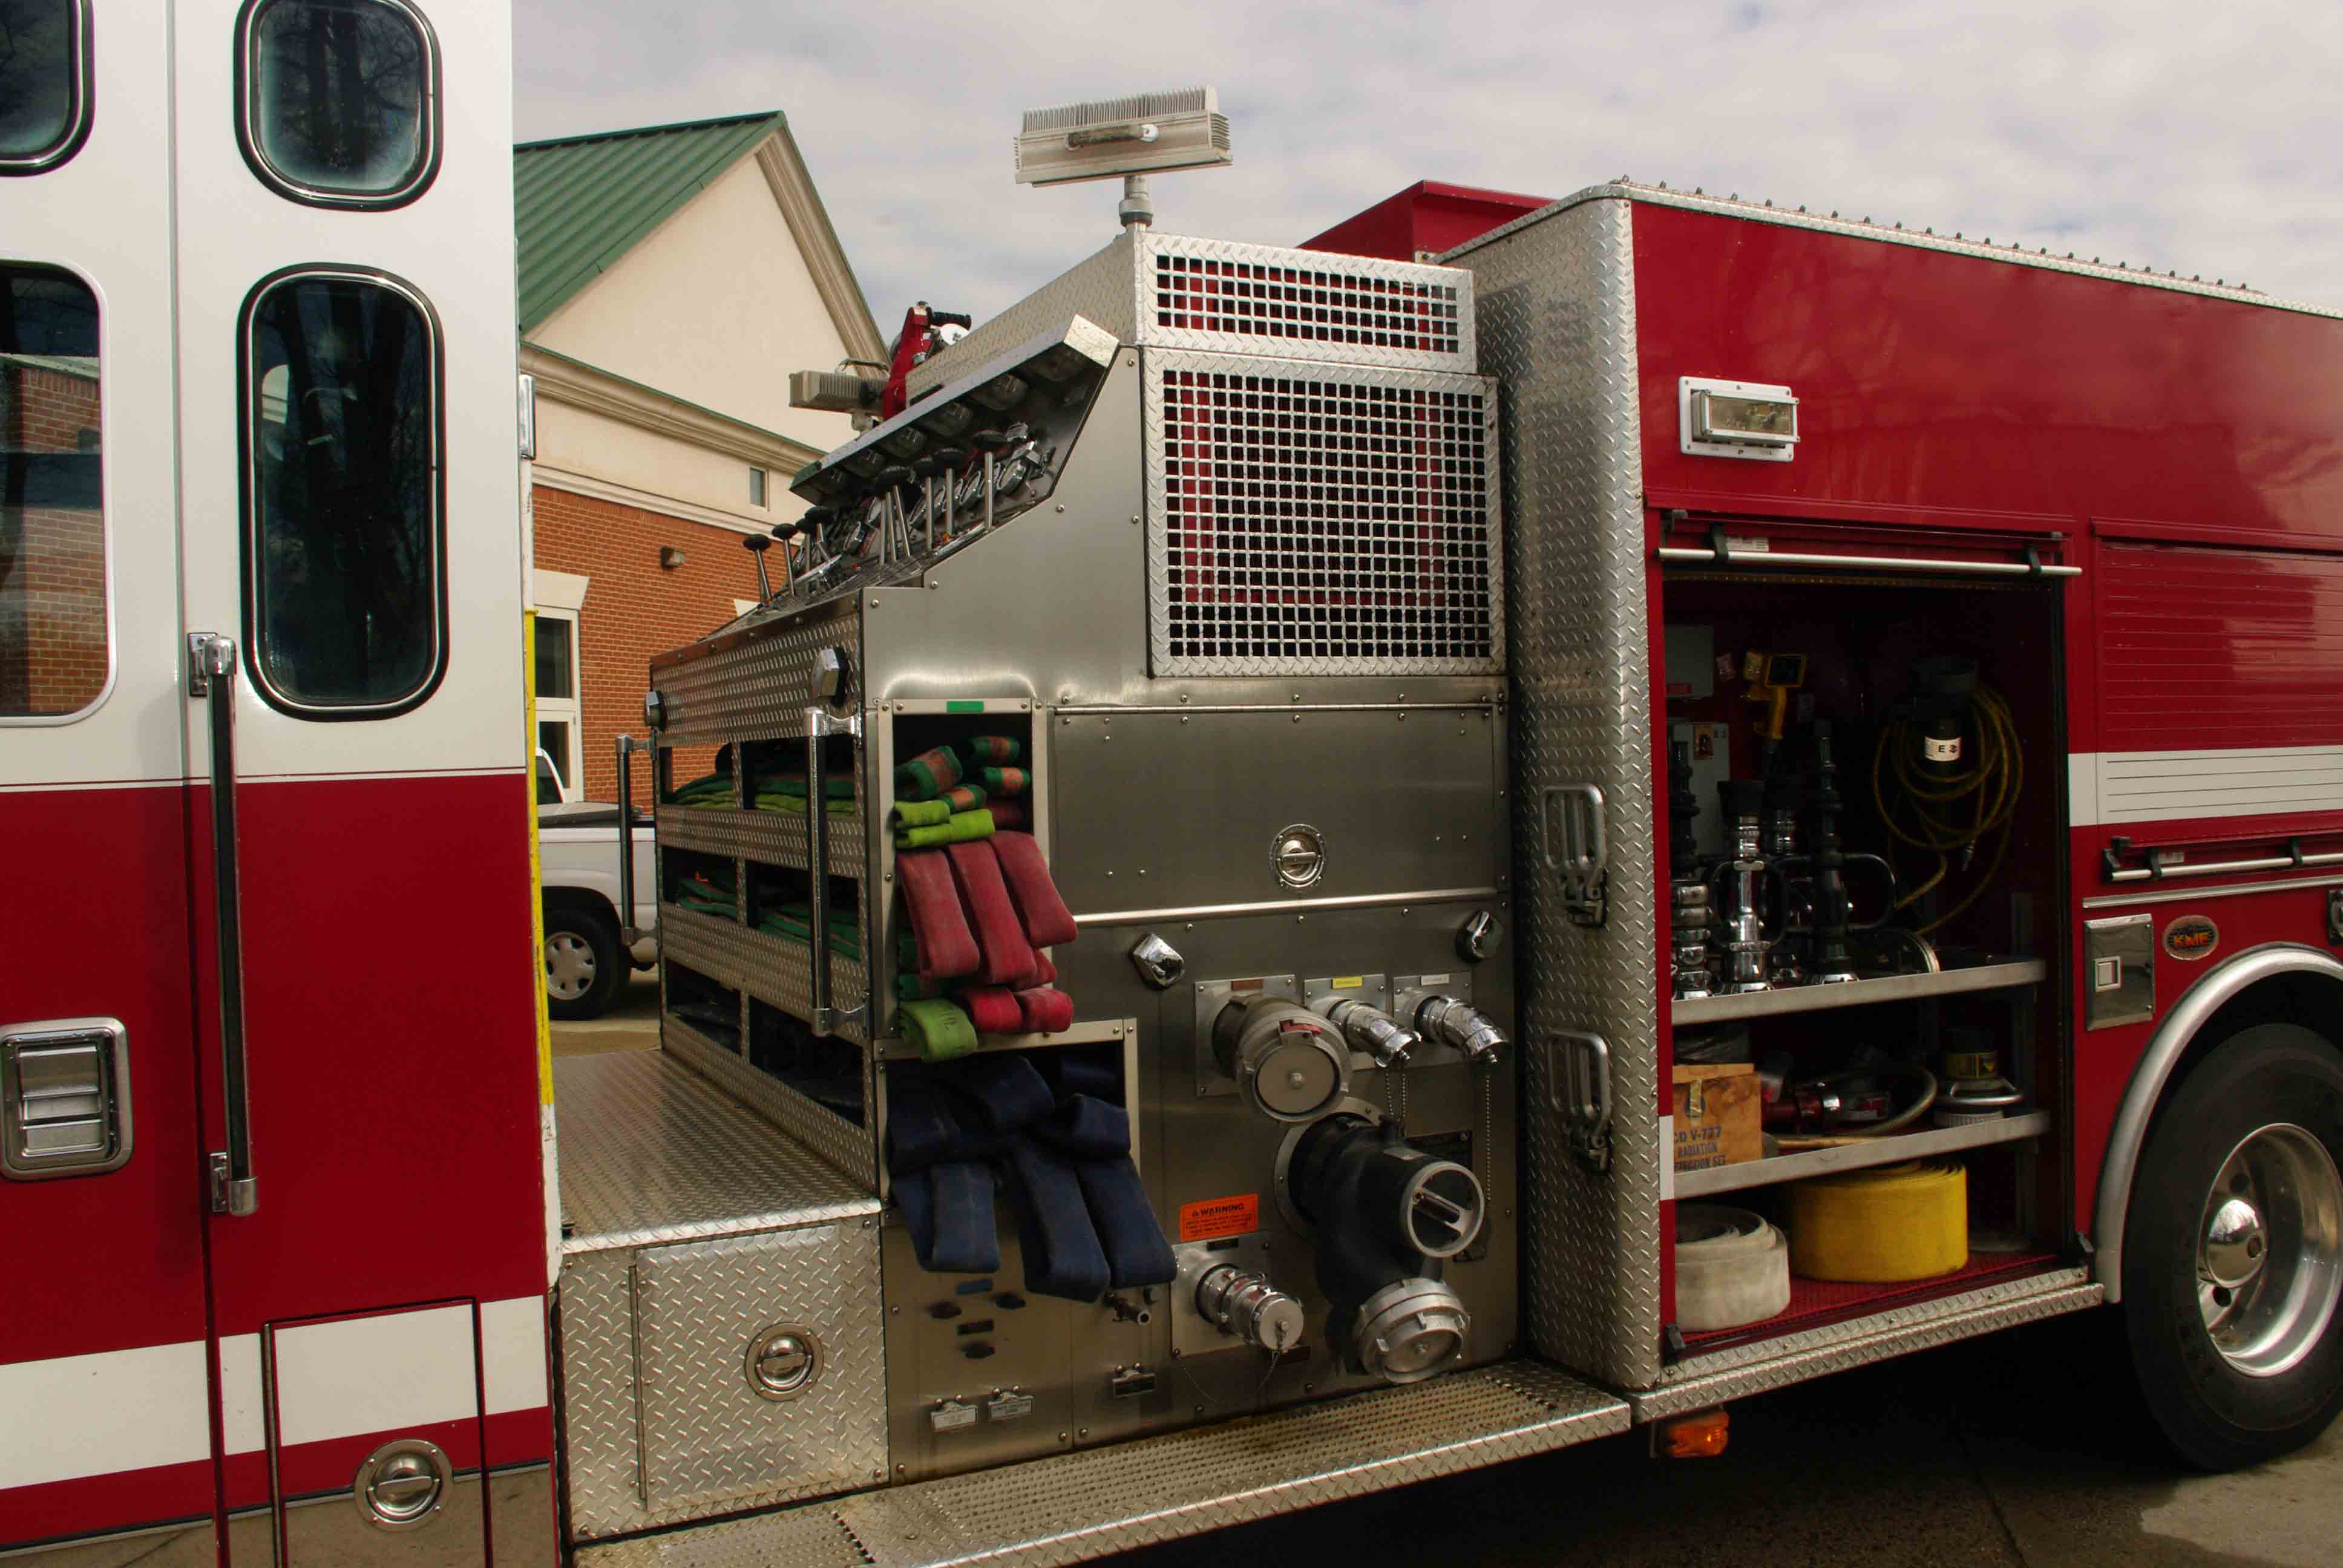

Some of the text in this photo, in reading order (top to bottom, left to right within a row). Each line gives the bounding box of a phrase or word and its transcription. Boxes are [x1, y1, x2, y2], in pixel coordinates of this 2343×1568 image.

[1938, 745, 1945, 753] E
[2173, 932, 2208, 947] KME
[1678, 1142, 1717, 1157] RADIATION
[1201, 1203, 1245, 1215] WARNING
